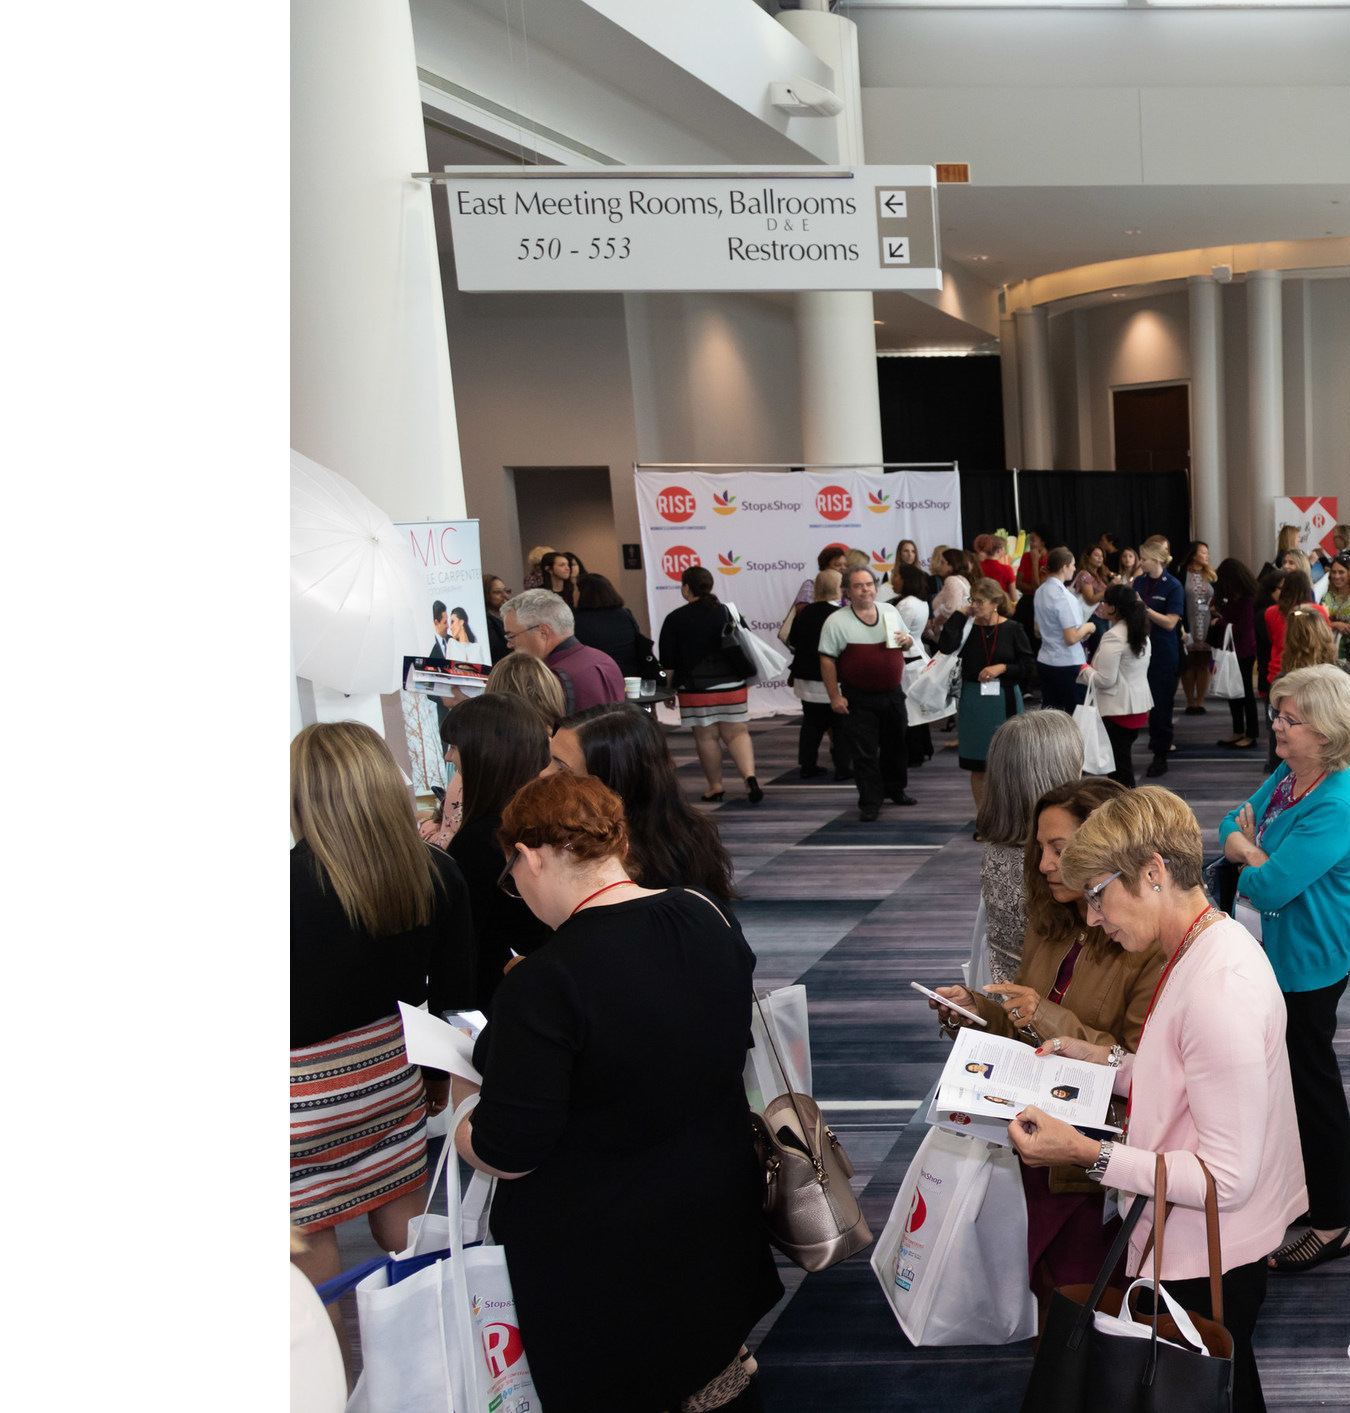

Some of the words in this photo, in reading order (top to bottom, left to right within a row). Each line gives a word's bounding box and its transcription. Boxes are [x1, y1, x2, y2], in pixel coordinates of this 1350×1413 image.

[457, 190, 507, 216] East
[515, 190, 624, 224] Meeting
[628, 190, 723, 219] Rooms,
[729, 187, 857, 215] Ballrooms
[766, 218, 778, 232] D
[783, 218, 794, 232] &
[802, 218, 810, 232] E
[517, 236, 562, 261] 550
[588, 236, 631, 261] 553
[727, 235, 860, 262] Restrooms
[657, 495, 696, 514] RISE
[741, 500, 801, 512] Stop&Shop
[816, 494, 852, 512] RISE
[895, 499, 951, 511] Stop&Shop
[663, 554, 699, 573] RISE
[746, 560, 804, 572] Stop&Shop
[438, 568, 482, 584] CARPENTE
[751, 620, 782, 631] Stop&
[756, 680, 787, 690] Stop&
[921, 1169, 942, 1186] &Shop
[484, 1300, 515, 1309] Stop&
